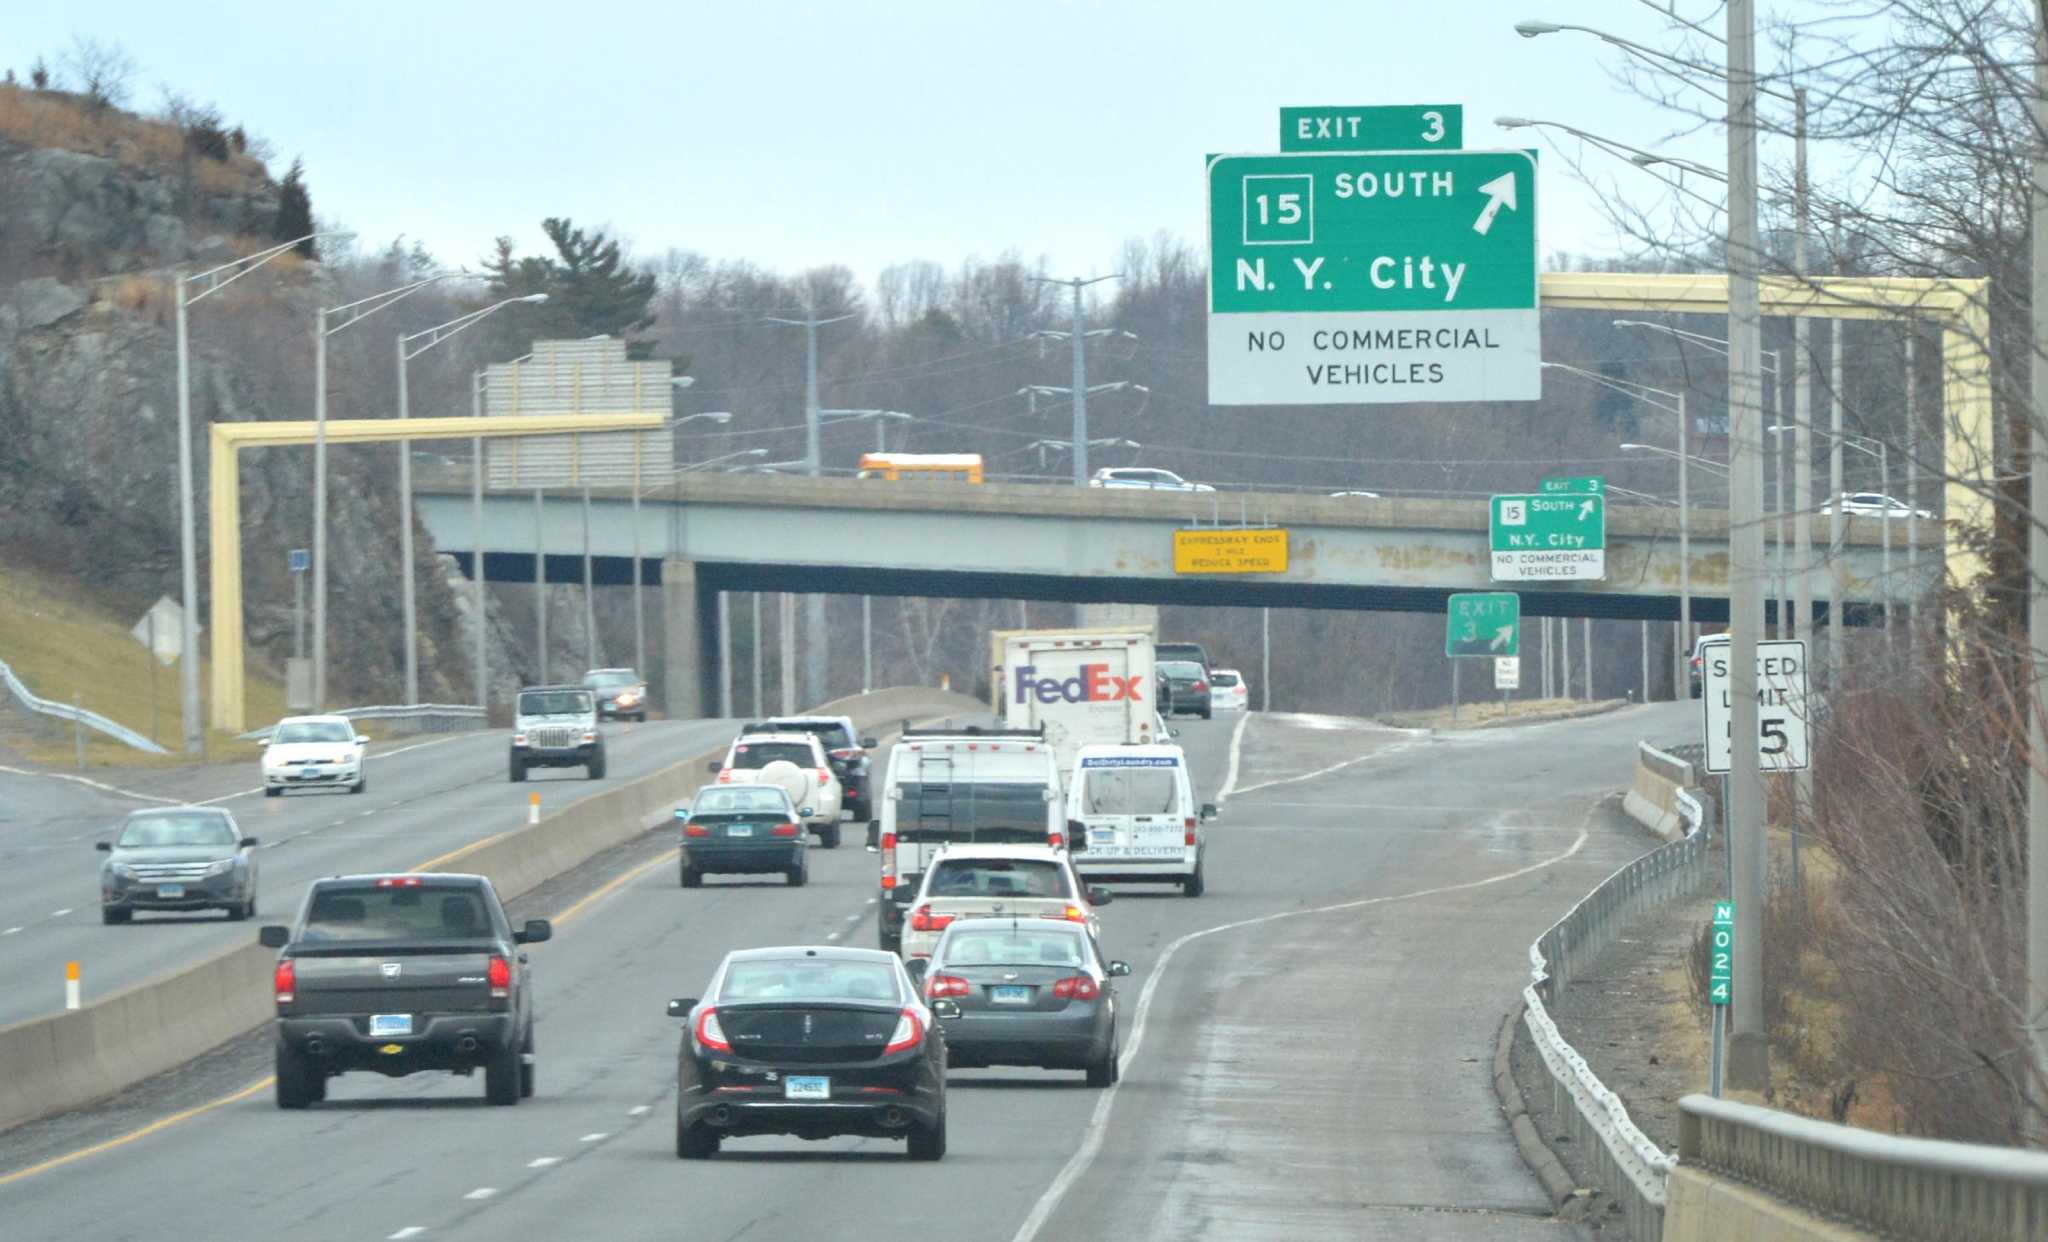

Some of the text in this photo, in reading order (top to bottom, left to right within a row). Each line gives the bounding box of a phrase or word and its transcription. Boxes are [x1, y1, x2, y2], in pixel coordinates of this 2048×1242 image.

[1298, 111, 1445, 143] EXIT 3
[1335, 171, 1454, 198] SOUTH
[1256, 194, 1302, 225] 15
[1236, 256, 1466, 302] N. Y. City
[1248, 328, 1500, 351] NO COMMERCIAL
[1306, 363, 1444, 386] VEHICLES
[1545, 479, 1599, 492] EXIT 3
[1506, 506, 1520, 520] 15
[1531, 499, 1575, 512] SOUTH
[1509, 532, 1585, 548] N.Y. City
[1497, 552, 1598, 564] NO COMMERCIAL
[1519, 566, 1577, 576] VEHICLES
[1460, 601, 1509, 617] EXIT
[1462, 622, 1477, 643] 3
[1713, 657, 1797, 678] SED
[1015, 664, 1143, 705] FedEx
[1718, 906, 1731, 919] N
[1713, 983, 1728, 999] 4
